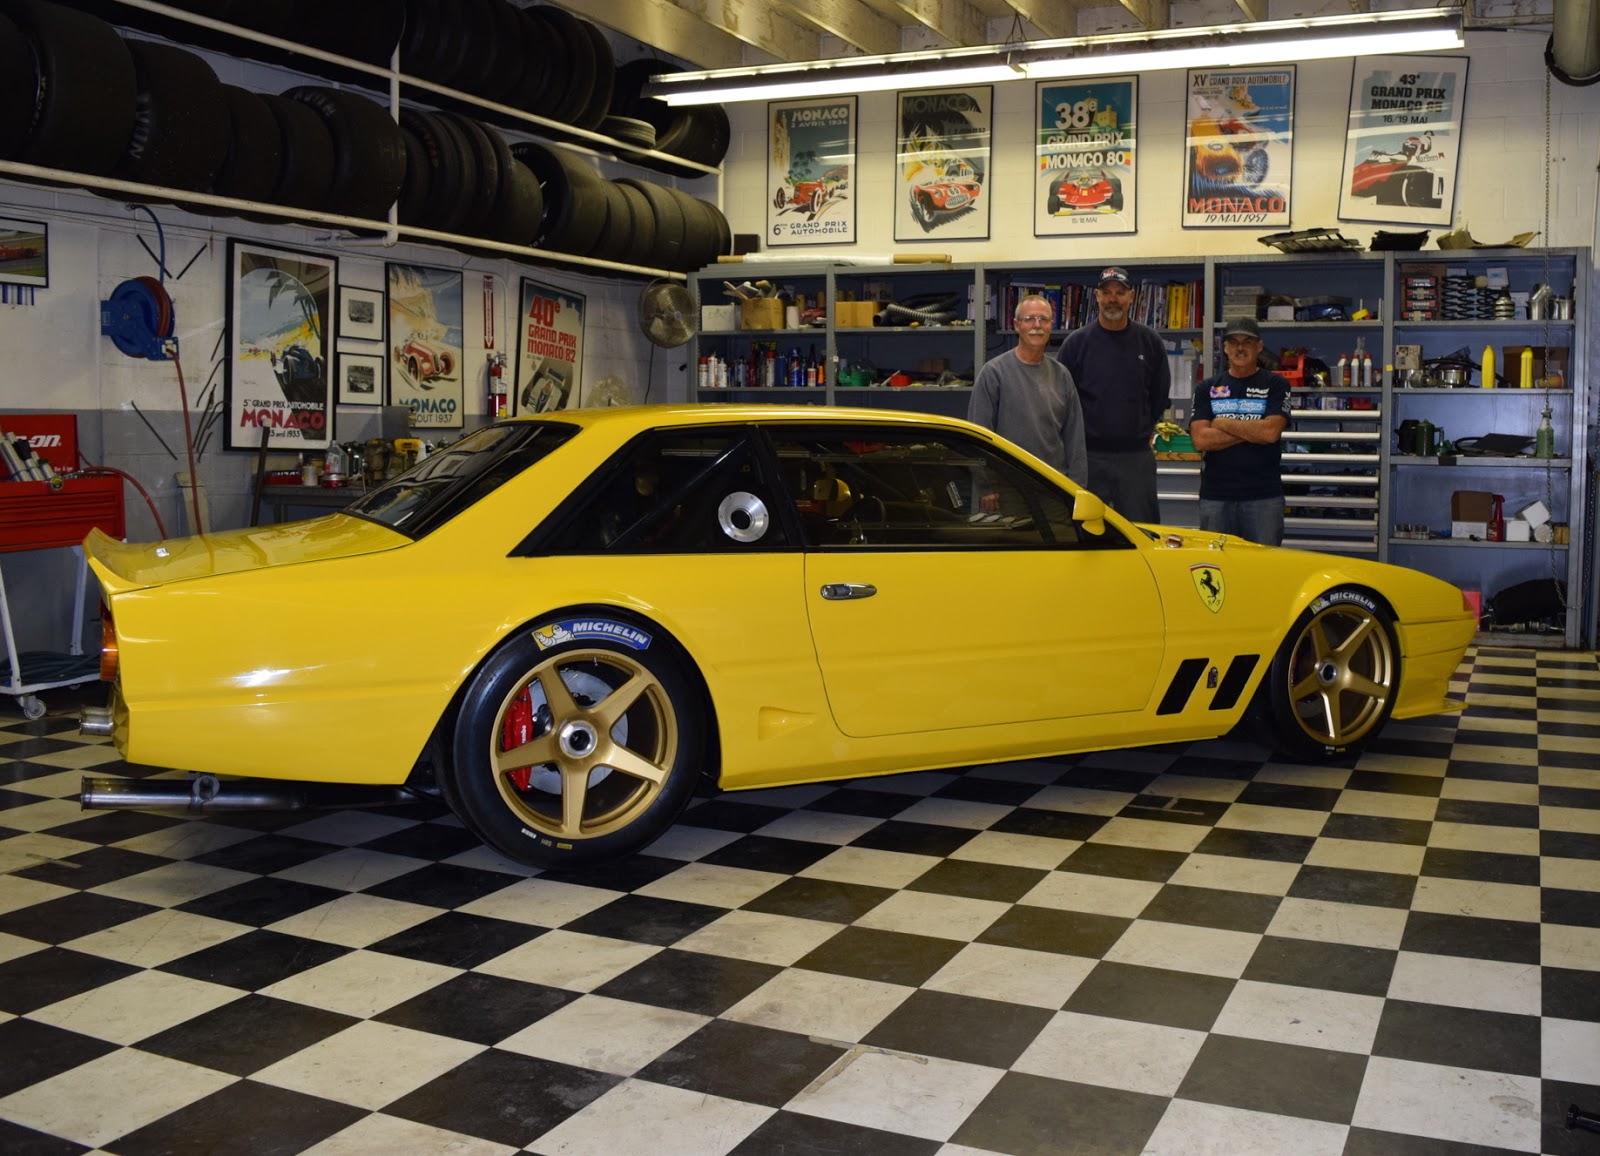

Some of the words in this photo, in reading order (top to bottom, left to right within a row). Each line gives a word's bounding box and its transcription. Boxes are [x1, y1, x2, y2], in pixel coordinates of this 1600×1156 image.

[1209, 77, 1230, 86] GRAND
[1232, 76, 1247, 85] PRIX
[1247, 74, 1287, 84] AUTOMOBILE
[1371, 86, 1413, 98] GRAND
[1415, 87, 1446, 99] PRIX
[903, 93, 971, 114] MONACO
[1371, 98, 1423, 111] MONACO
[791, 107, 849, 122] MONACO
[1055, 101, 1098, 130] 38e
[1410, 116, 1428, 124] MAI
[1046, 134, 1091, 151] GRAND
[1094, 131, 1124, 148] PRIX
[1046, 151, 1103, 169] MONACO
[1106, 150, 1126, 166] 80
[1189, 196, 1285, 213] MONACO
[1205, 214, 1217, 223] 19
[1218, 213, 1241, 223] MAI
[1242, 213, 1268, 223] 1957
[791, 226, 848, 235] AUTOMOBILE
[529, 295, 561, 328] 40e
[528, 323, 557, 343] GRAND
[558, 331, 577, 348] PRIX
[527, 337, 564, 360] MONACO
[565, 347, 576, 363] 82
[252, 400, 271, 408] GRAND
[272, 401, 285, 409] PRIX
[286, 401, 325, 410] AUTOMOBILE
[240, 408, 325, 430] MONACO
[416, 414, 433, 423] OUT
[435, 414, 453, 423] 1937
[286, 430, 301, 438] 1933
[1330, 592, 1376, 610] MICHELIN
[572, 621, 648, 645] MICHELIN
